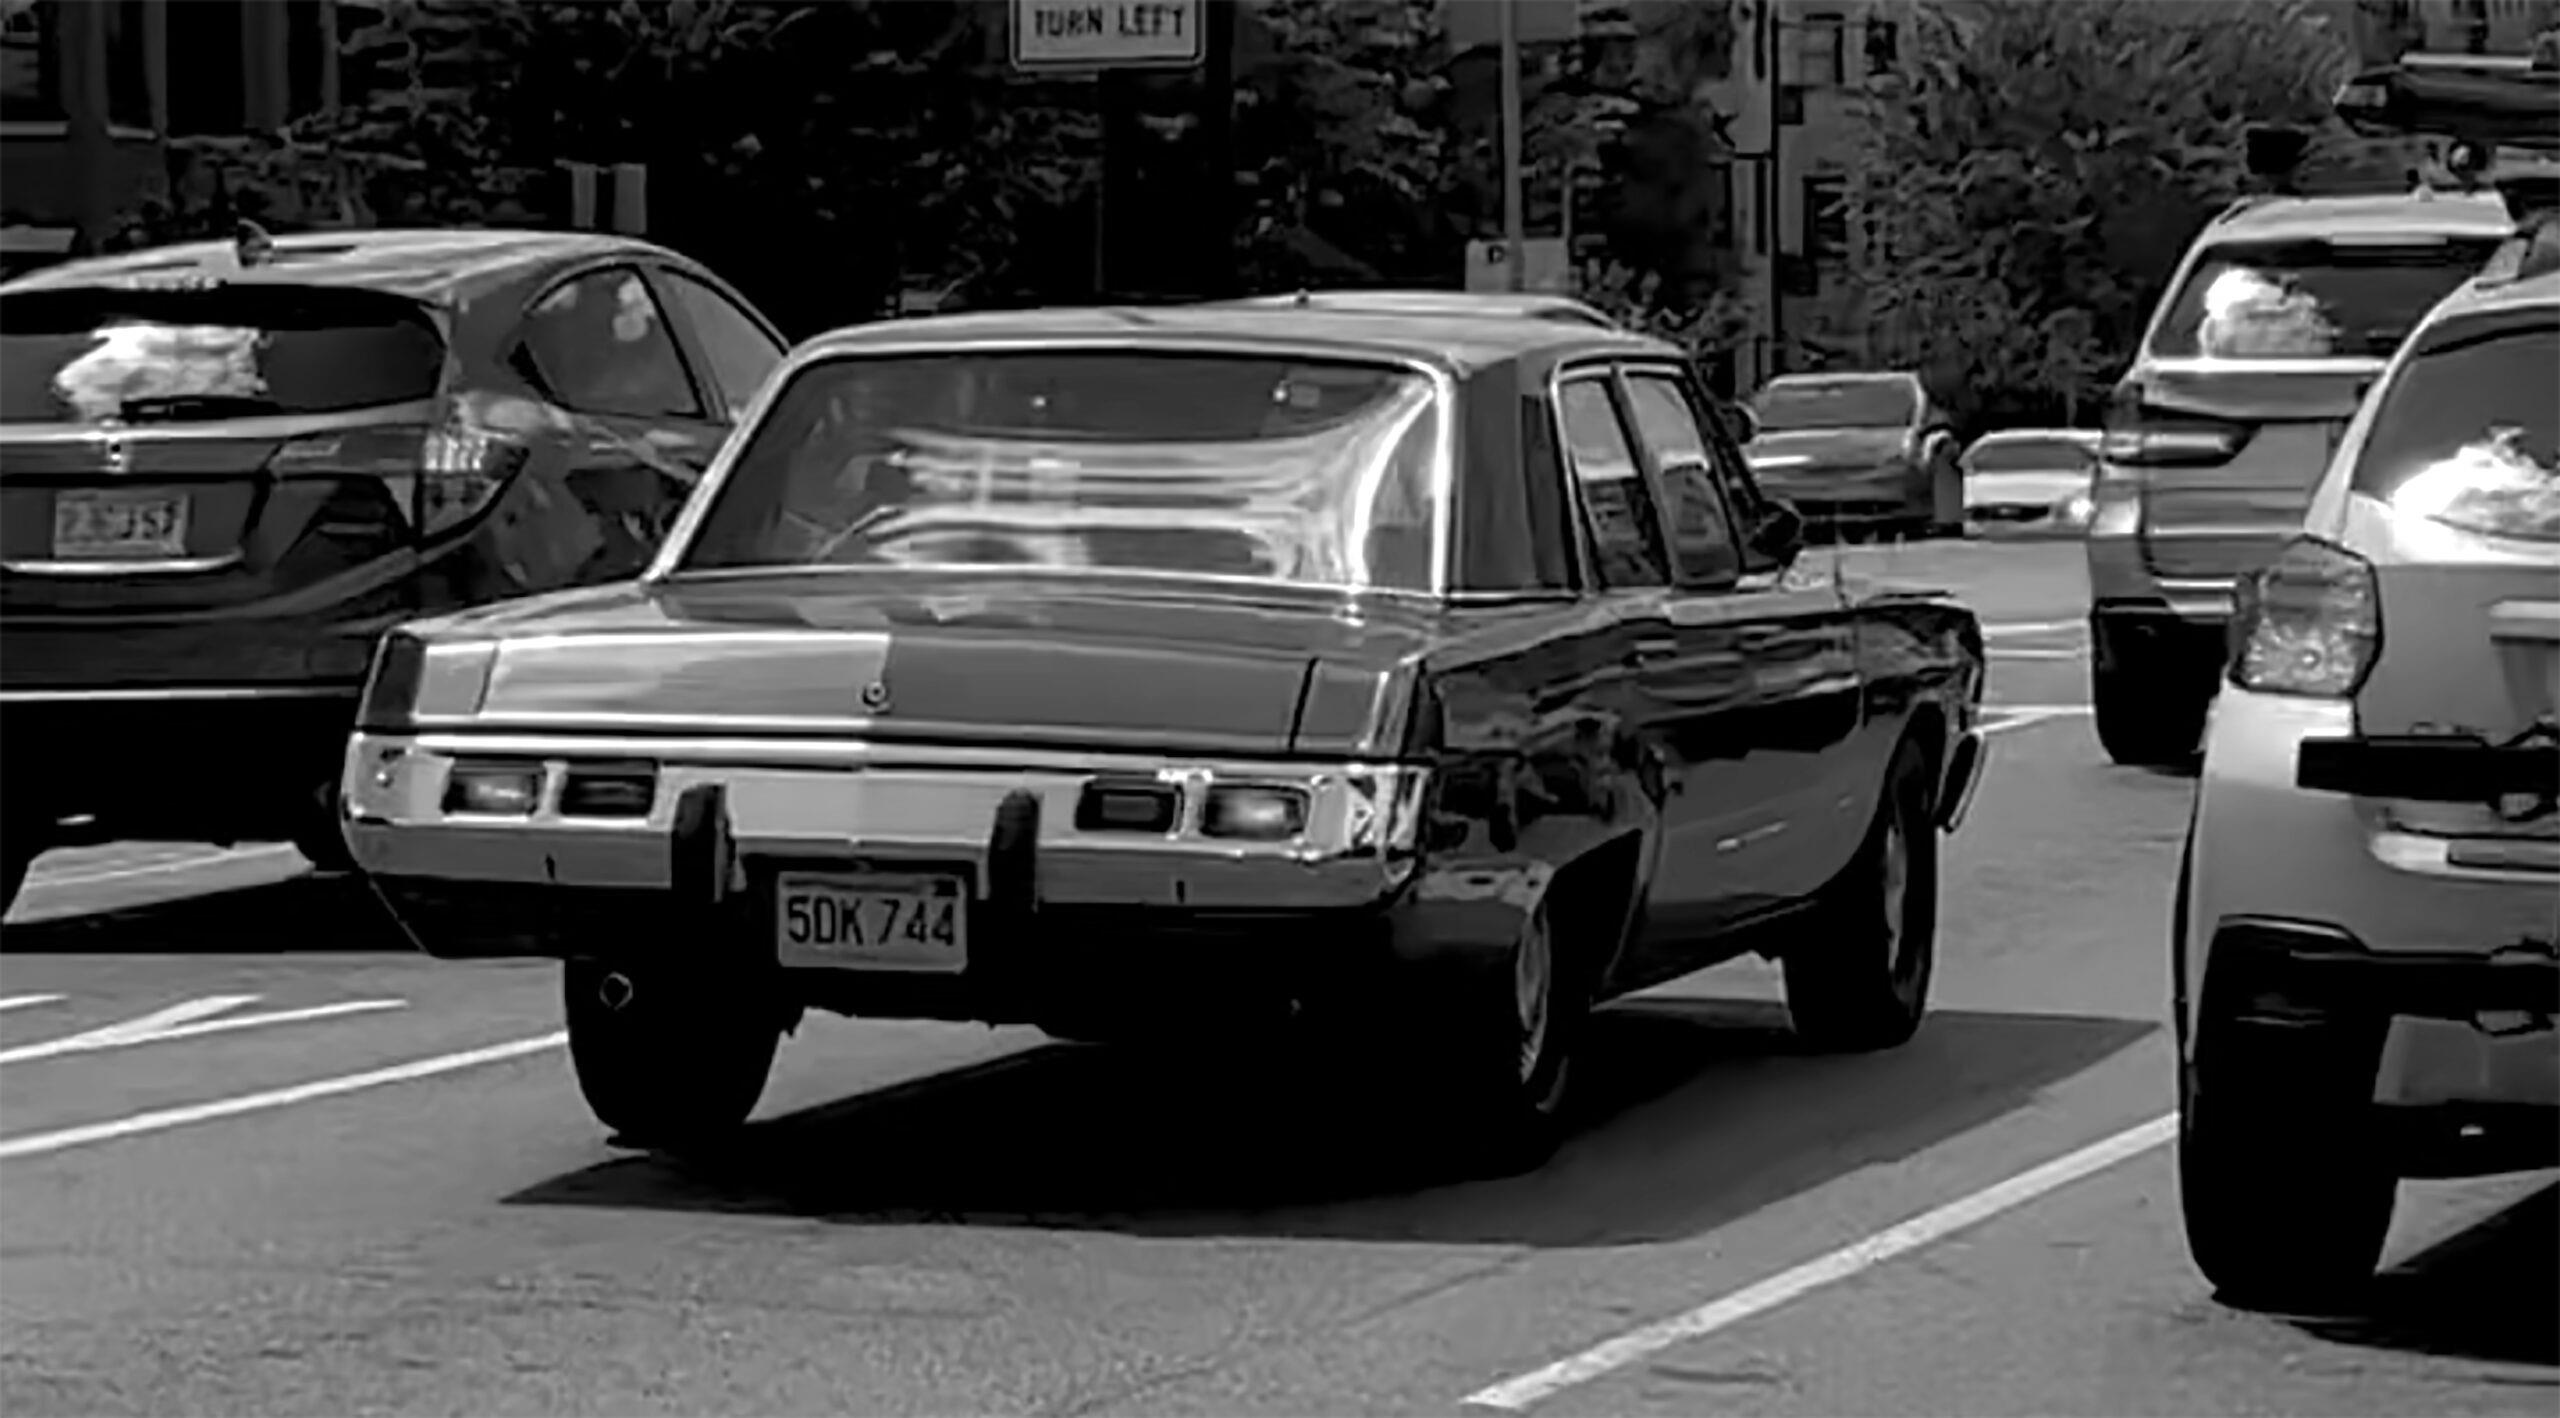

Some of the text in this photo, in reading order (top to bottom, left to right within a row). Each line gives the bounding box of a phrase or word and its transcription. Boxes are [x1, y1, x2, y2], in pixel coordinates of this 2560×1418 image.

[1035, 4, 1185, 37] TURN LEFT
[876, 897, 955, 947] 744
